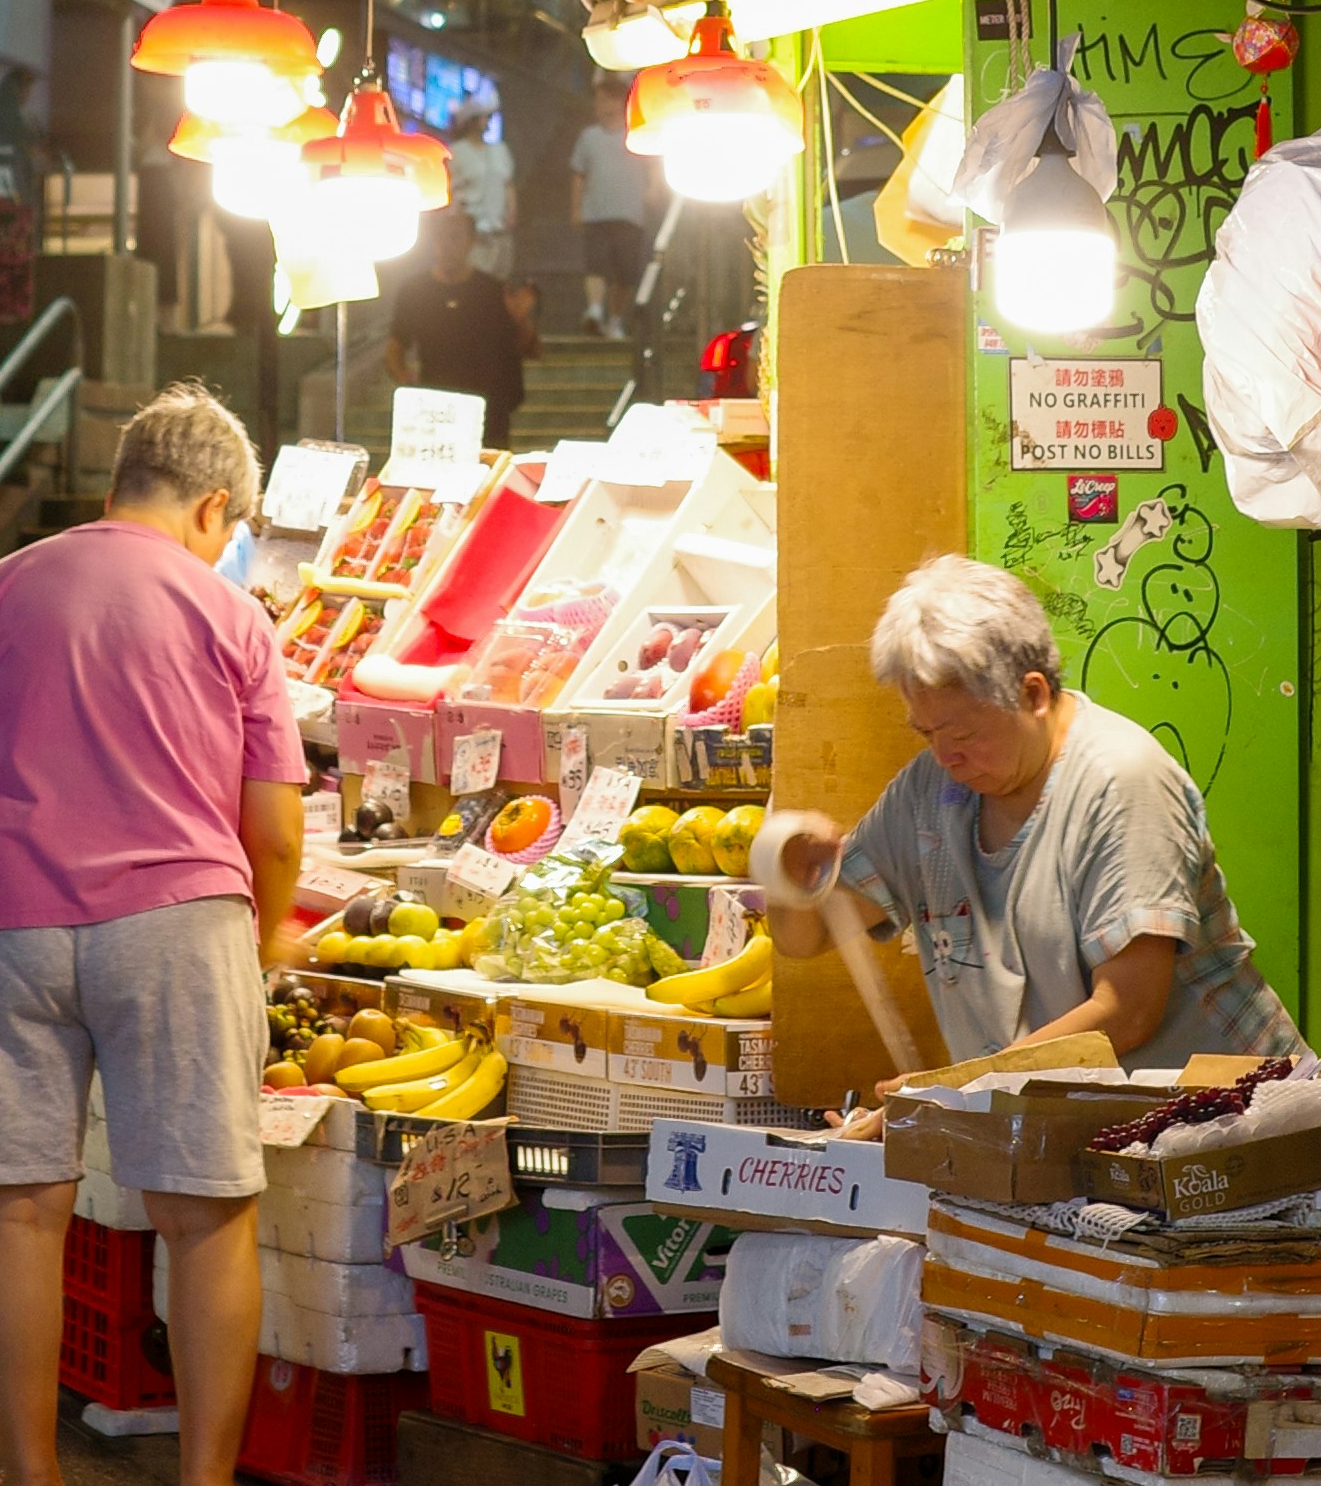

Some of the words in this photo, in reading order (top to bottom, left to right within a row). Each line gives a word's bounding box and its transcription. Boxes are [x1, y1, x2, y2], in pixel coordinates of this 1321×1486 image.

[1055, 368, 1125, 388] 請勿塗鴉
[1029, 392, 1058, 409] NO
[1063, 392, 1146, 409] GRAFFITI
[1055, 419, 1126, 440] 請勿標貼
[1021, 444, 1068, 460] POST
[1074, 444, 1102, 460] NO
[1108, 444, 1155, 460] BILLS
[738, 1156, 846, 1195] CHERRIES
[1173, 1170, 1230, 1200] Koala
[1179, 1192, 1227, 1214] GOLD
[533, 1282, 569, 1304] GRAPES
